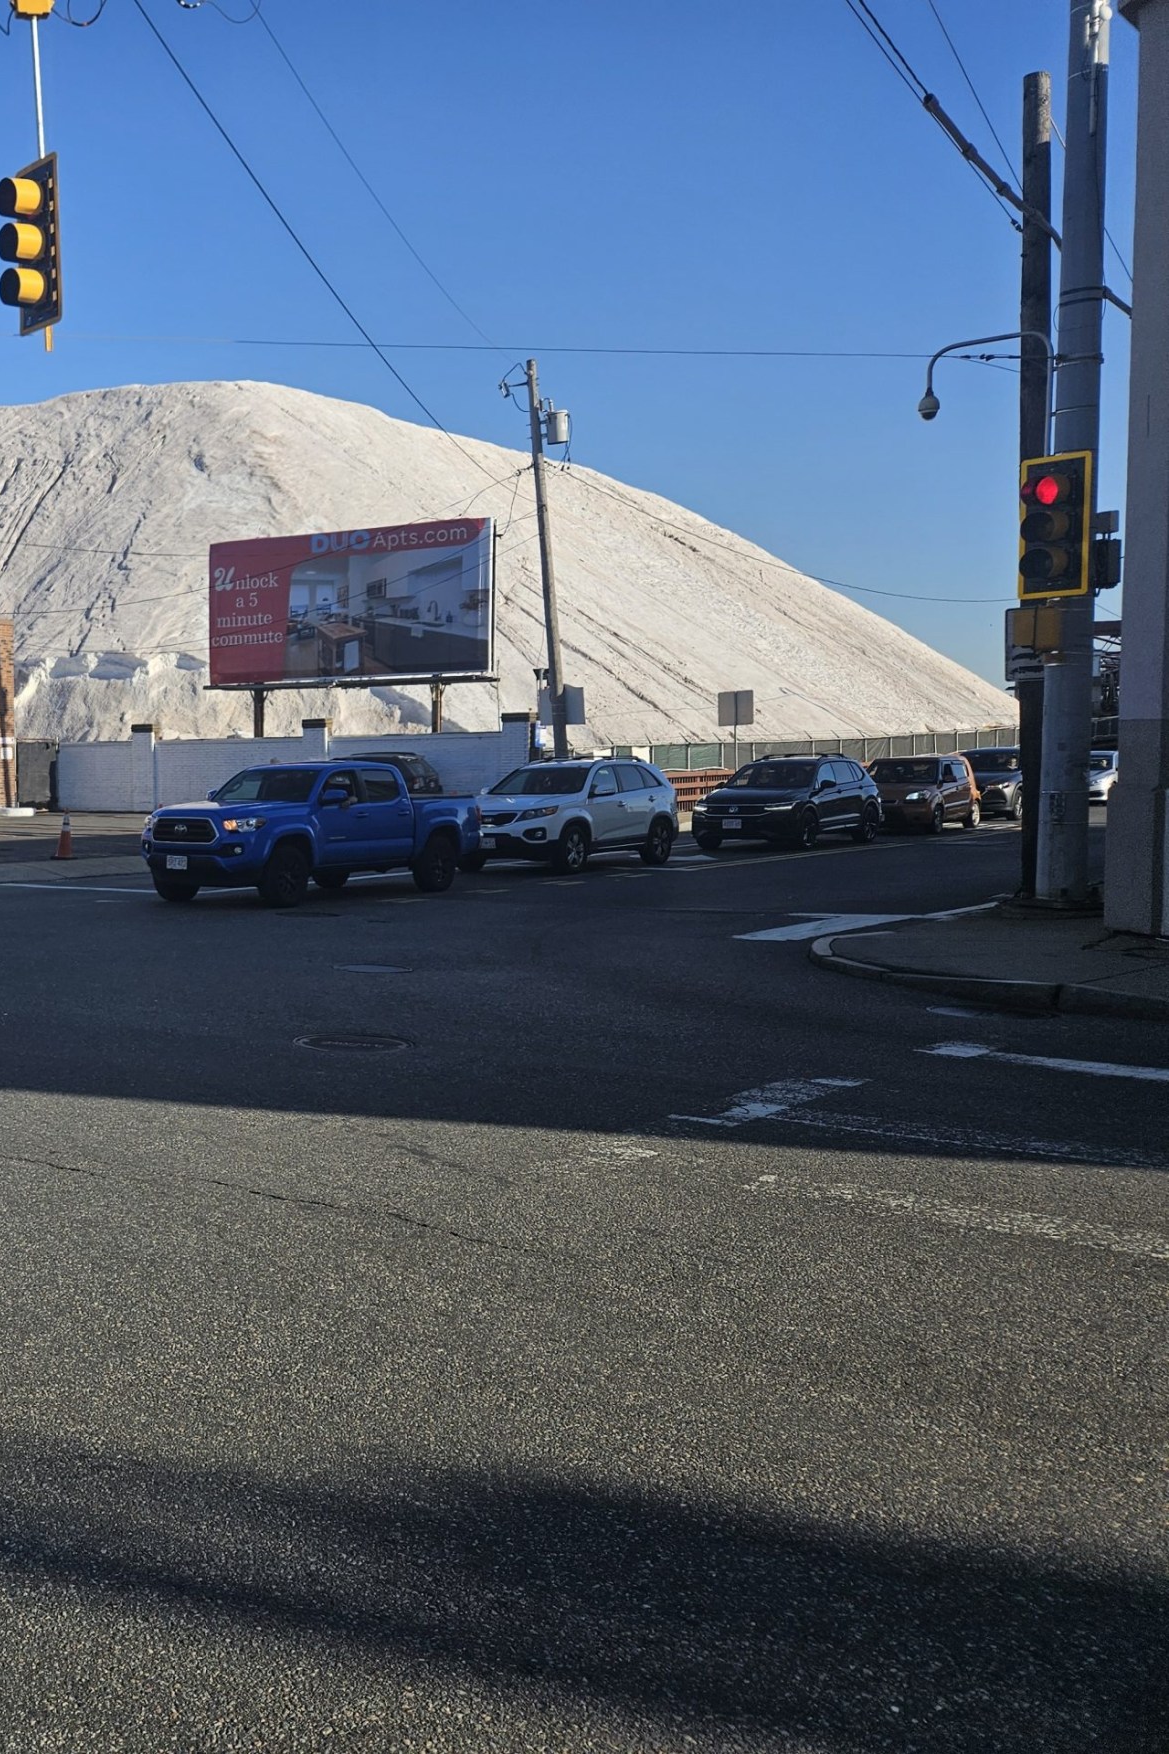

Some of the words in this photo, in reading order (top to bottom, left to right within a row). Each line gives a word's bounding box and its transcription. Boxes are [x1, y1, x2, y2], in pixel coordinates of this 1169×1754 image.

[214, 566, 279, 591] Unlock
[236, 597, 245, 608] a
[249, 592, 259, 607] 5
[217, 613, 273, 628] minute
[211, 631, 284, 647] commute
